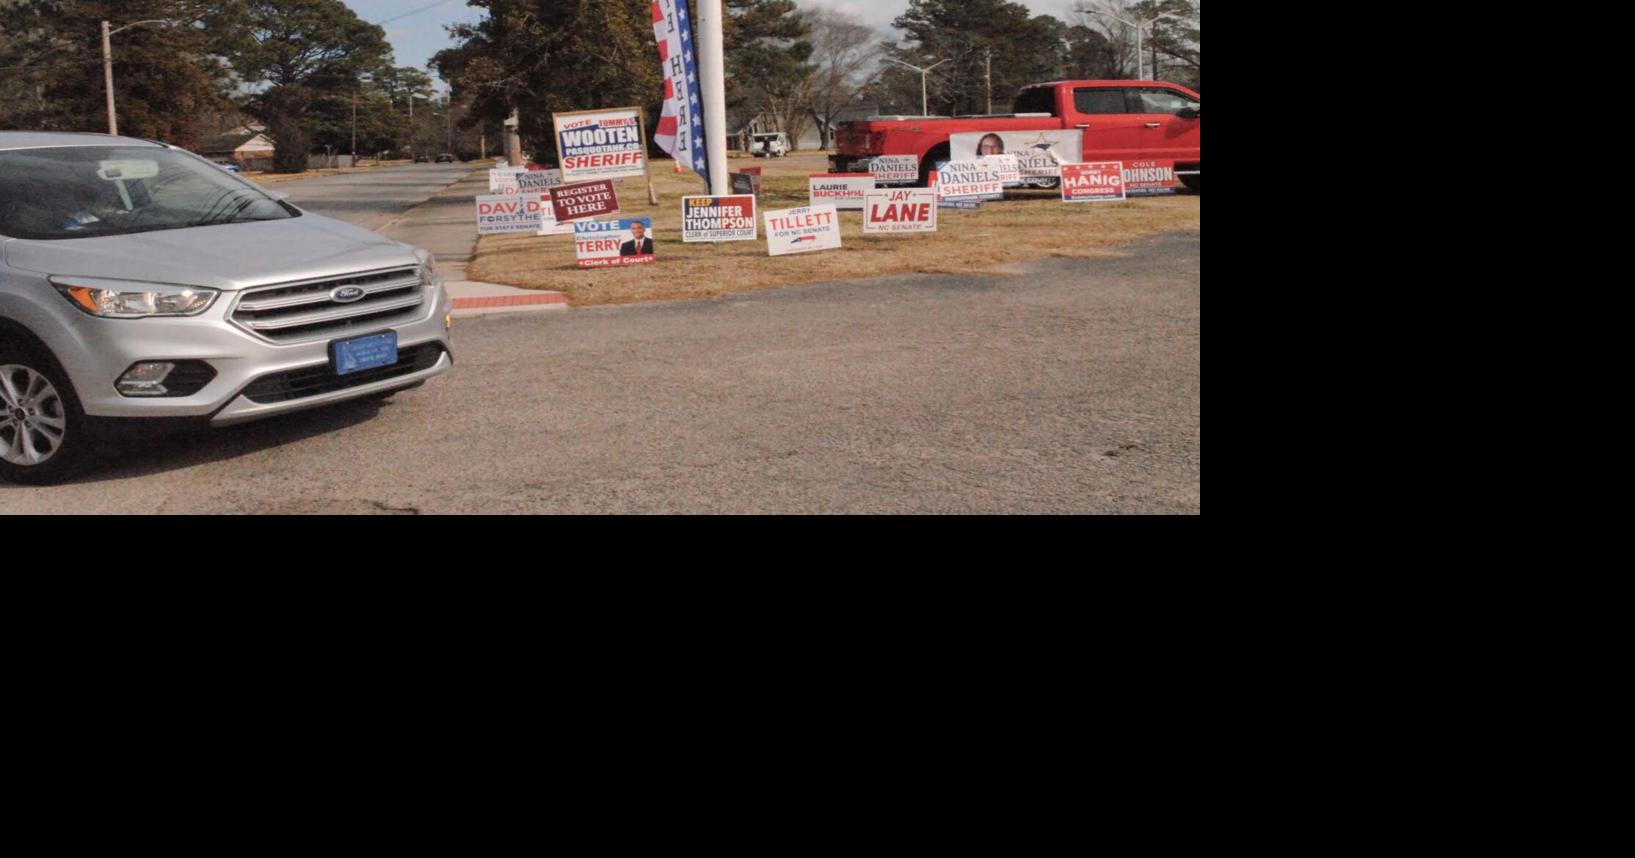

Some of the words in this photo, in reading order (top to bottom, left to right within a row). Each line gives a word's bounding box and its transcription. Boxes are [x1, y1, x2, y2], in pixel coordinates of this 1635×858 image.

[564, 119, 592, 129] VOTE
[563, 127, 639, 147] WOOTEN
[565, 152, 643, 169] SHERIFF
[1018, 157, 1058, 168] NIELS
[870, 163, 917, 173] DANIELS
[951, 163, 976, 172] NINA
[941, 171, 1000, 184] DANIELS
[1064, 175, 1121, 188] HANIG
[1124, 168, 1172, 183] OHNSON
[519, 177, 560, 189] DANIELS
[557, 184, 608, 197] REGISTER
[813, 190, 864, 198] BUCKHOU
[943, 184, 999, 195] SHERIFF
[1072, 187, 1114, 195] CONGRESS
[557, 199, 575, 208] TO
[576, 192, 612, 203] VOTE
[889, 190, 912, 202] JAY
[567, 202, 607, 215] HERE
[688, 198, 712, 207] KEEP
[686, 205, 742, 218] JENNIFER
[870, 203, 931, 222] LANE
[479, 214, 541, 222] FORSYTHE
[685, 217, 753, 230] THOMPSON
[769, 212, 832, 230] TILLETT
[576, 220, 619, 231] VOTE
[803, 226, 831, 234] SENATE
[892, 223, 922, 231] SENATE
[576, 239, 621, 253] TERRY
[584, 259, 608, 267] Clerk
[622, 255, 648, 264] Court
